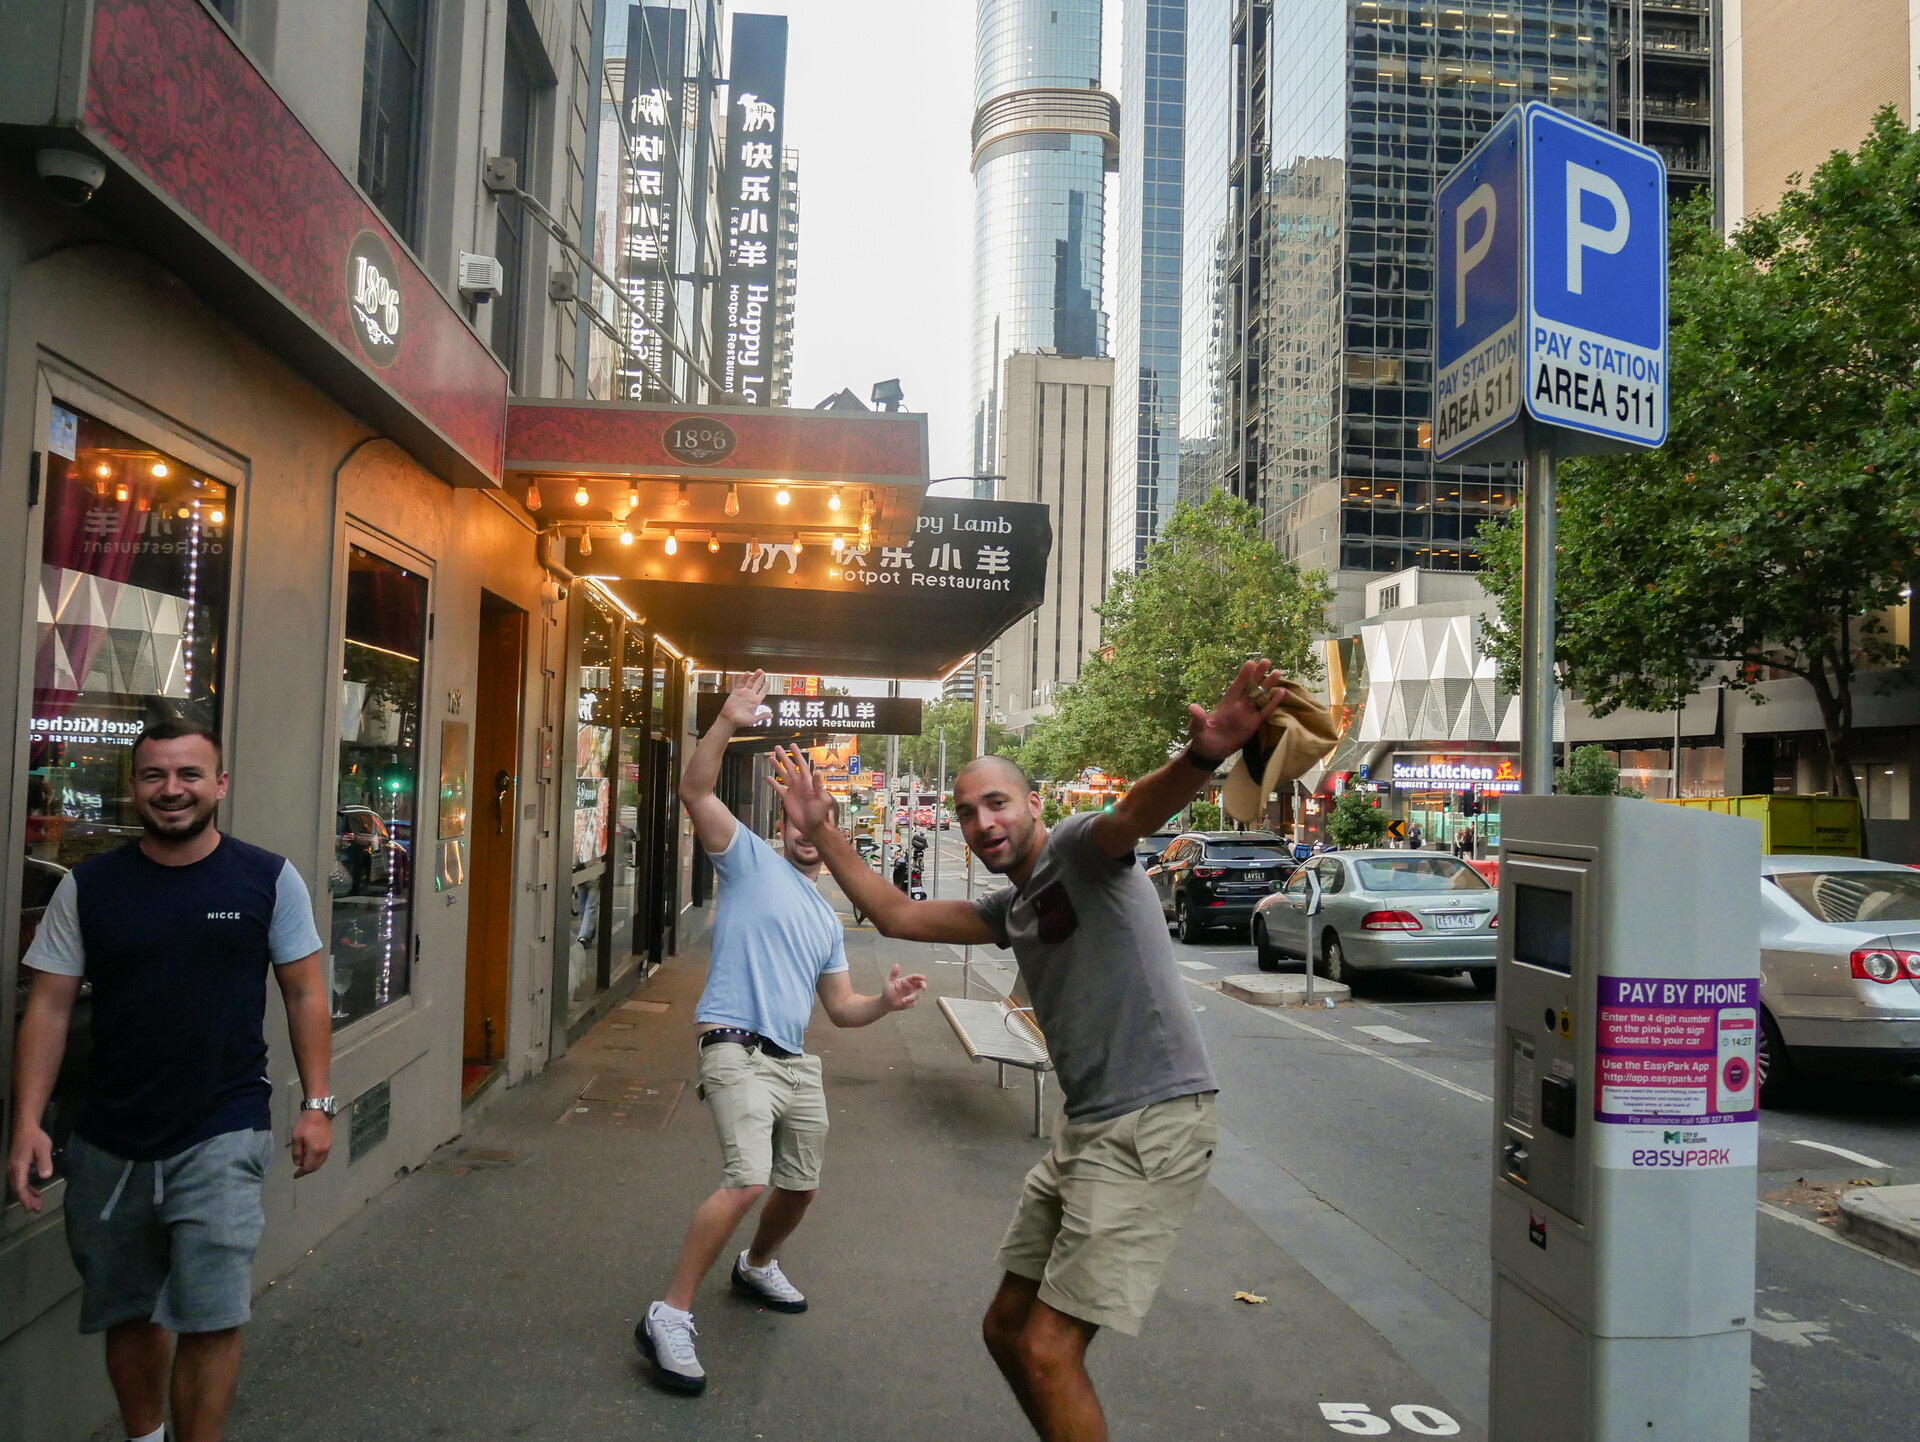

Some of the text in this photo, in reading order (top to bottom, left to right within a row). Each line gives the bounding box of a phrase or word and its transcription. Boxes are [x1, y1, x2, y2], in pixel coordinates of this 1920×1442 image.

[737, 141, 773, 268] 快乐小羊
[1565, 159, 1631, 295] P
[1455, 182, 1497, 329] P
[725, 284, 740, 394] Hotpot Restaurant
[737, 283, 769, 405] Happy La
[1438, 328, 1517, 400] PAY STATION
[1534, 326, 1660, 386] PAY STATION
[1437, 365, 1513, 446] AREA 511
[1535, 363, 1654, 428] AREA 511
[953, 512, 1013, 535] Lamb
[829, 568, 1011, 592] Hotpot Restaurant
[779, 699, 876, 720] 快乐小羊
[779, 718, 876, 729] Hotpot Restaurant
[1393, 763, 1493, 780] Secret Kitchen
[207, 911, 241, 920] NICCE
[1437, 915, 1473, 926] XET 424
[1619, 982, 1747, 1004] PAY BY PHONE
[1602, 1012, 1711, 1025] Enter the 4 digit number
[1609, 1023, 1705, 1036] on the pink pole sign
[1615, 1035, 1700, 1047] closest to your car
[1731, 1036, 1752, 1047] 14:27
[1602, 1059, 1710, 1073] Use the EasyPark App
[1603, 1073, 1707, 1084] http://app.easypark.net
[1628, 1115, 1641, 1123] For
[1642, 1116, 1680, 1125] assistance
[1682, 1116, 1694, 1125] call
[1695, 1116, 1710, 1125] 1300
[1722, 1115, 1734, 1123] 975
[1318, 1402, 1461, 1436] 50
